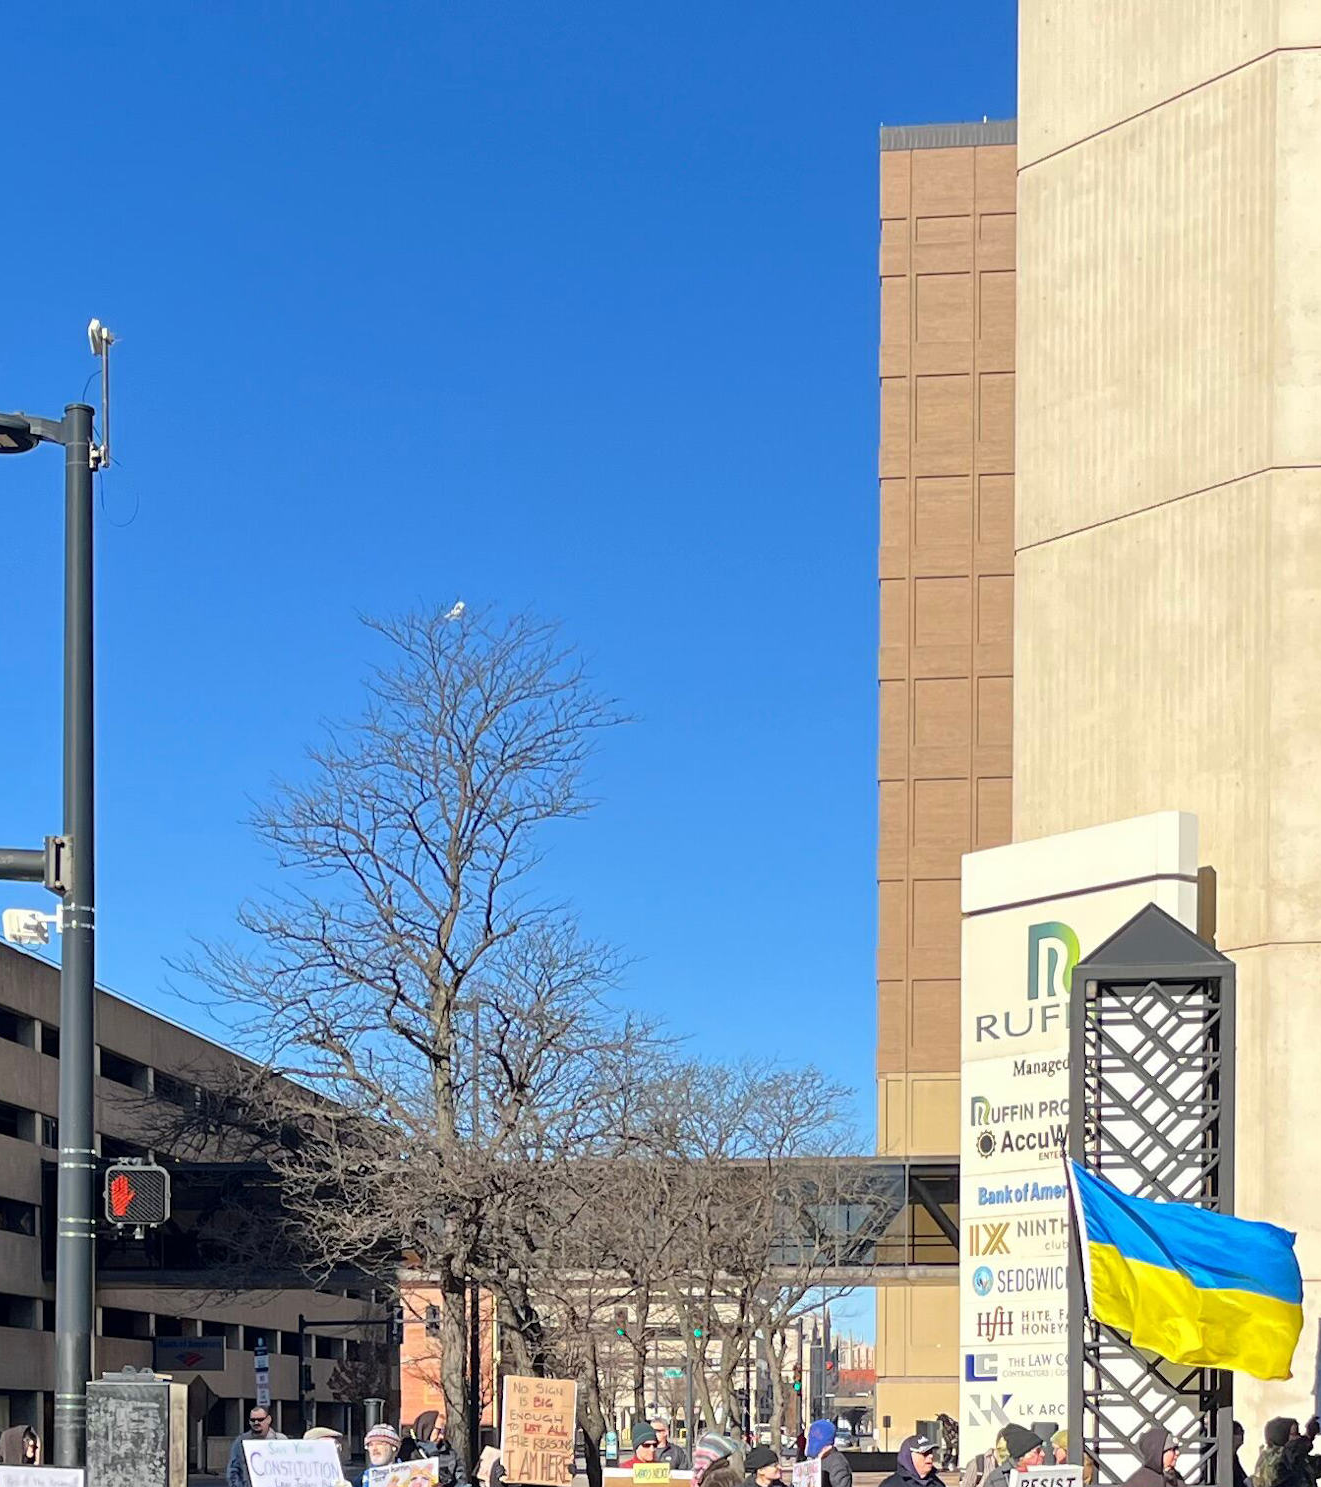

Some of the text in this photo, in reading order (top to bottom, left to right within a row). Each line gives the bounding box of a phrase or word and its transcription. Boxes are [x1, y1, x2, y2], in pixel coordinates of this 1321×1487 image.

[978, 1184, 1012, 1206] Bank
[1014, 1183, 1030, 1203] of
[1008, 1357, 1026, 1368] THE
[1028, 1353, 1052, 1367] LAW
[535, 1383, 564, 1396] SIGN
[533, 1396, 553, 1408] BIG
[510, 1409, 564, 1423] ENOUGH
[1019, 1404, 1034, 1416] LK
[524, 1423, 542, 1434] LIST
[547, 1425, 568, 1436] ALL
[506, 1435, 529, 1447] THE
[519, 1450, 538, 1481] AM
[541, 1453, 572, 1483] HERE
